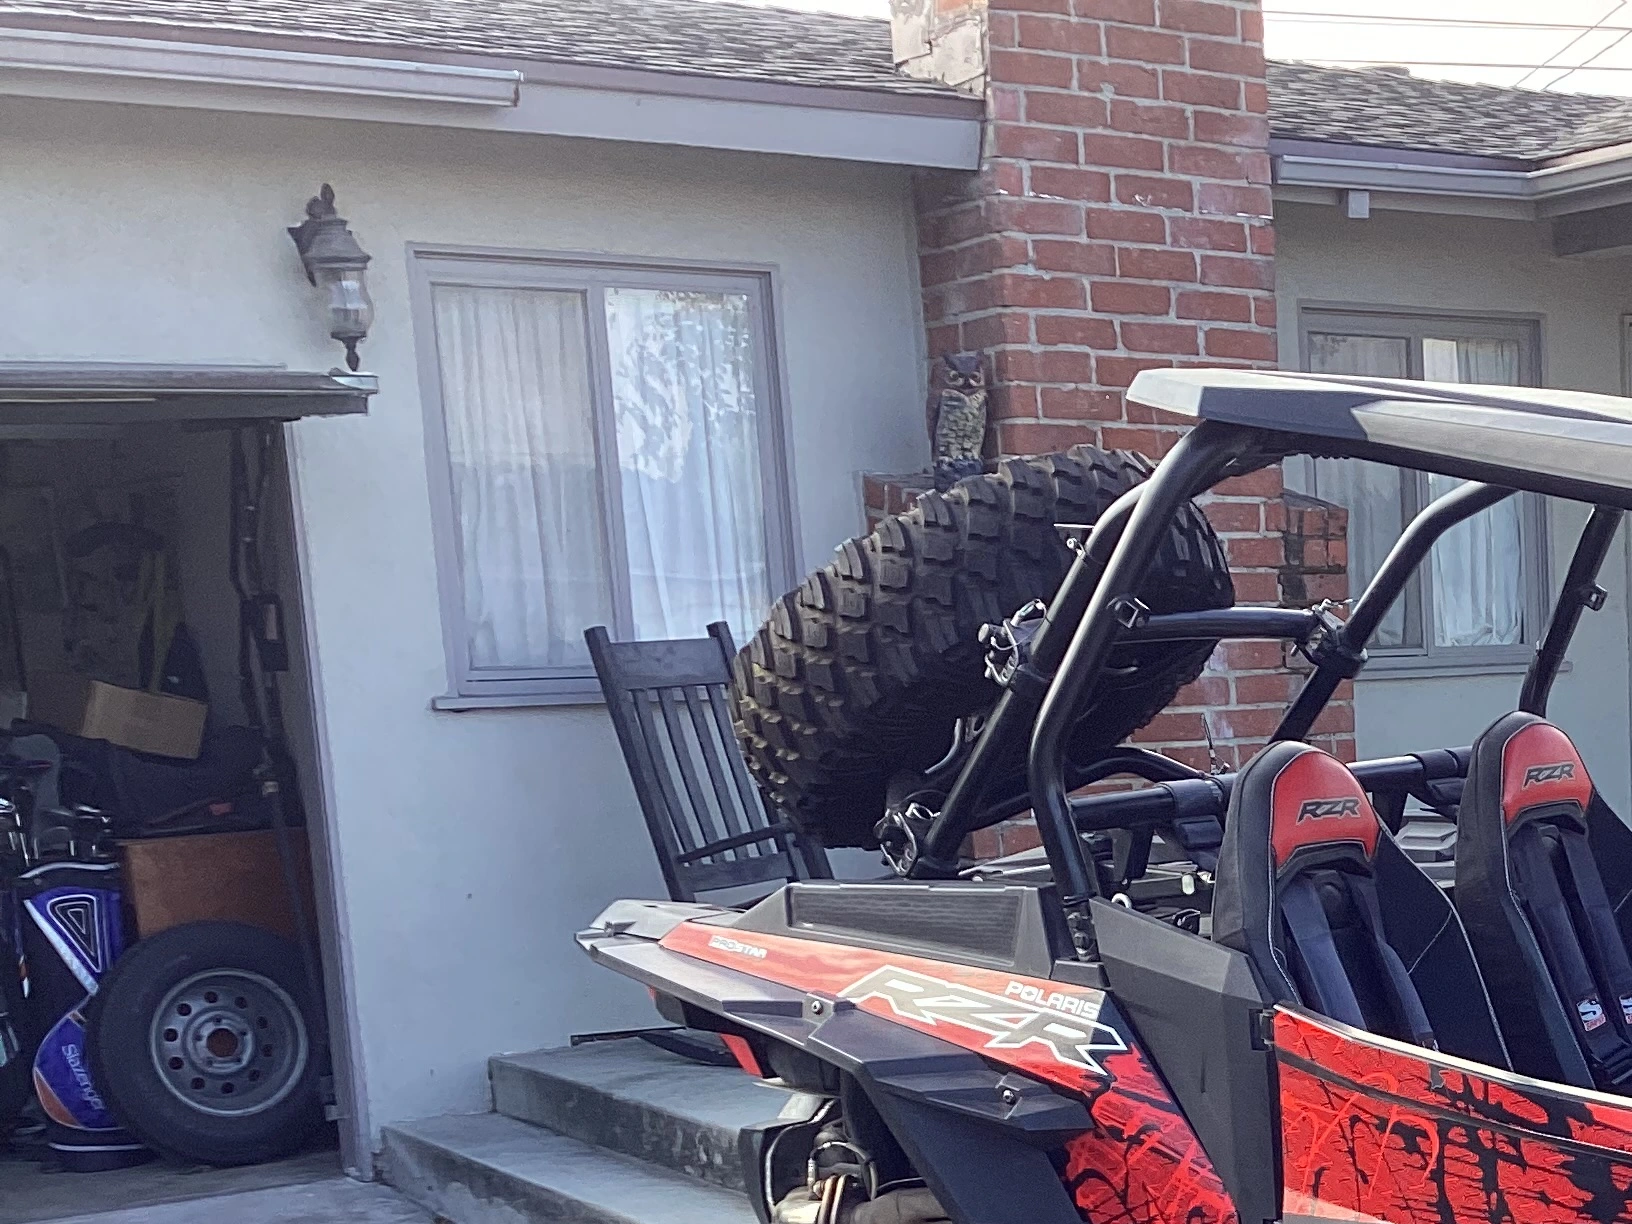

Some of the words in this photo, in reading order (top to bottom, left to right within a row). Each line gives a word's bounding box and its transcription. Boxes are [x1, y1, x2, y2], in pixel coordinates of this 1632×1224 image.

[1522, 761, 1576, 791] RZR
[1296, 796, 1361, 825] RZR
[1005, 980, 1100, 1020] POLARIS
[836, 964, 1128, 1075] RZR
